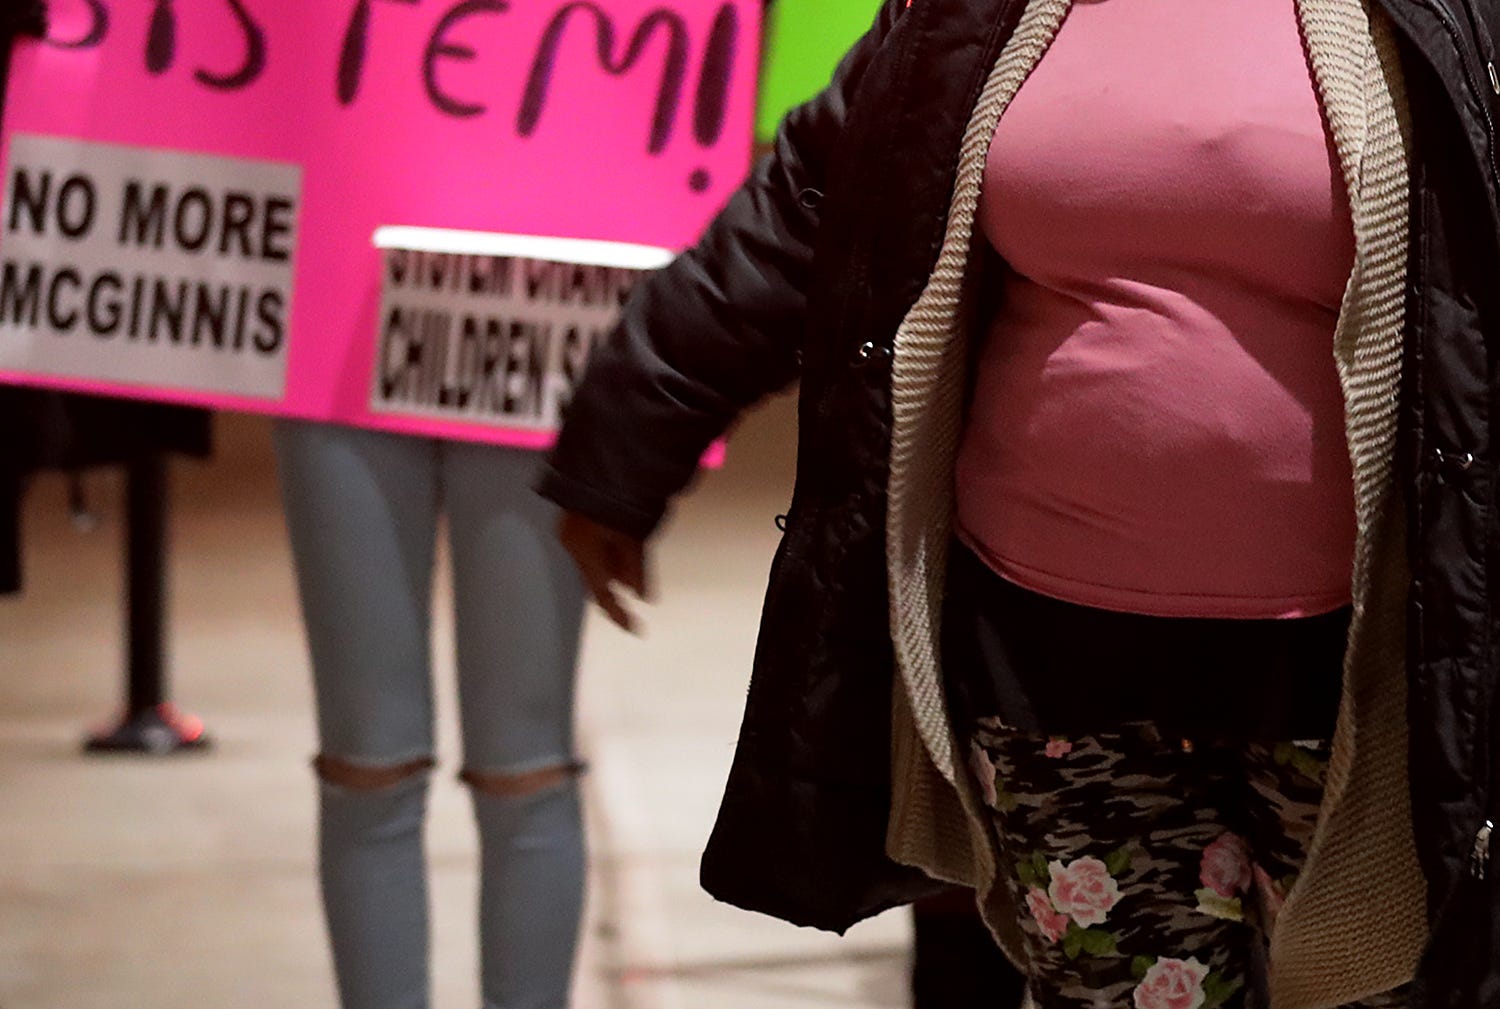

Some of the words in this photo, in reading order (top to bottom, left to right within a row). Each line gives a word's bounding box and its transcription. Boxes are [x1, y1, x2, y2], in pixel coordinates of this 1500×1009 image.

[9, 167, 97, 240] NO
[119, 178, 293, 261] MORE
[0, 262, 285, 354] MCGINNIS
[382, 307, 550, 420] CHILDREN
